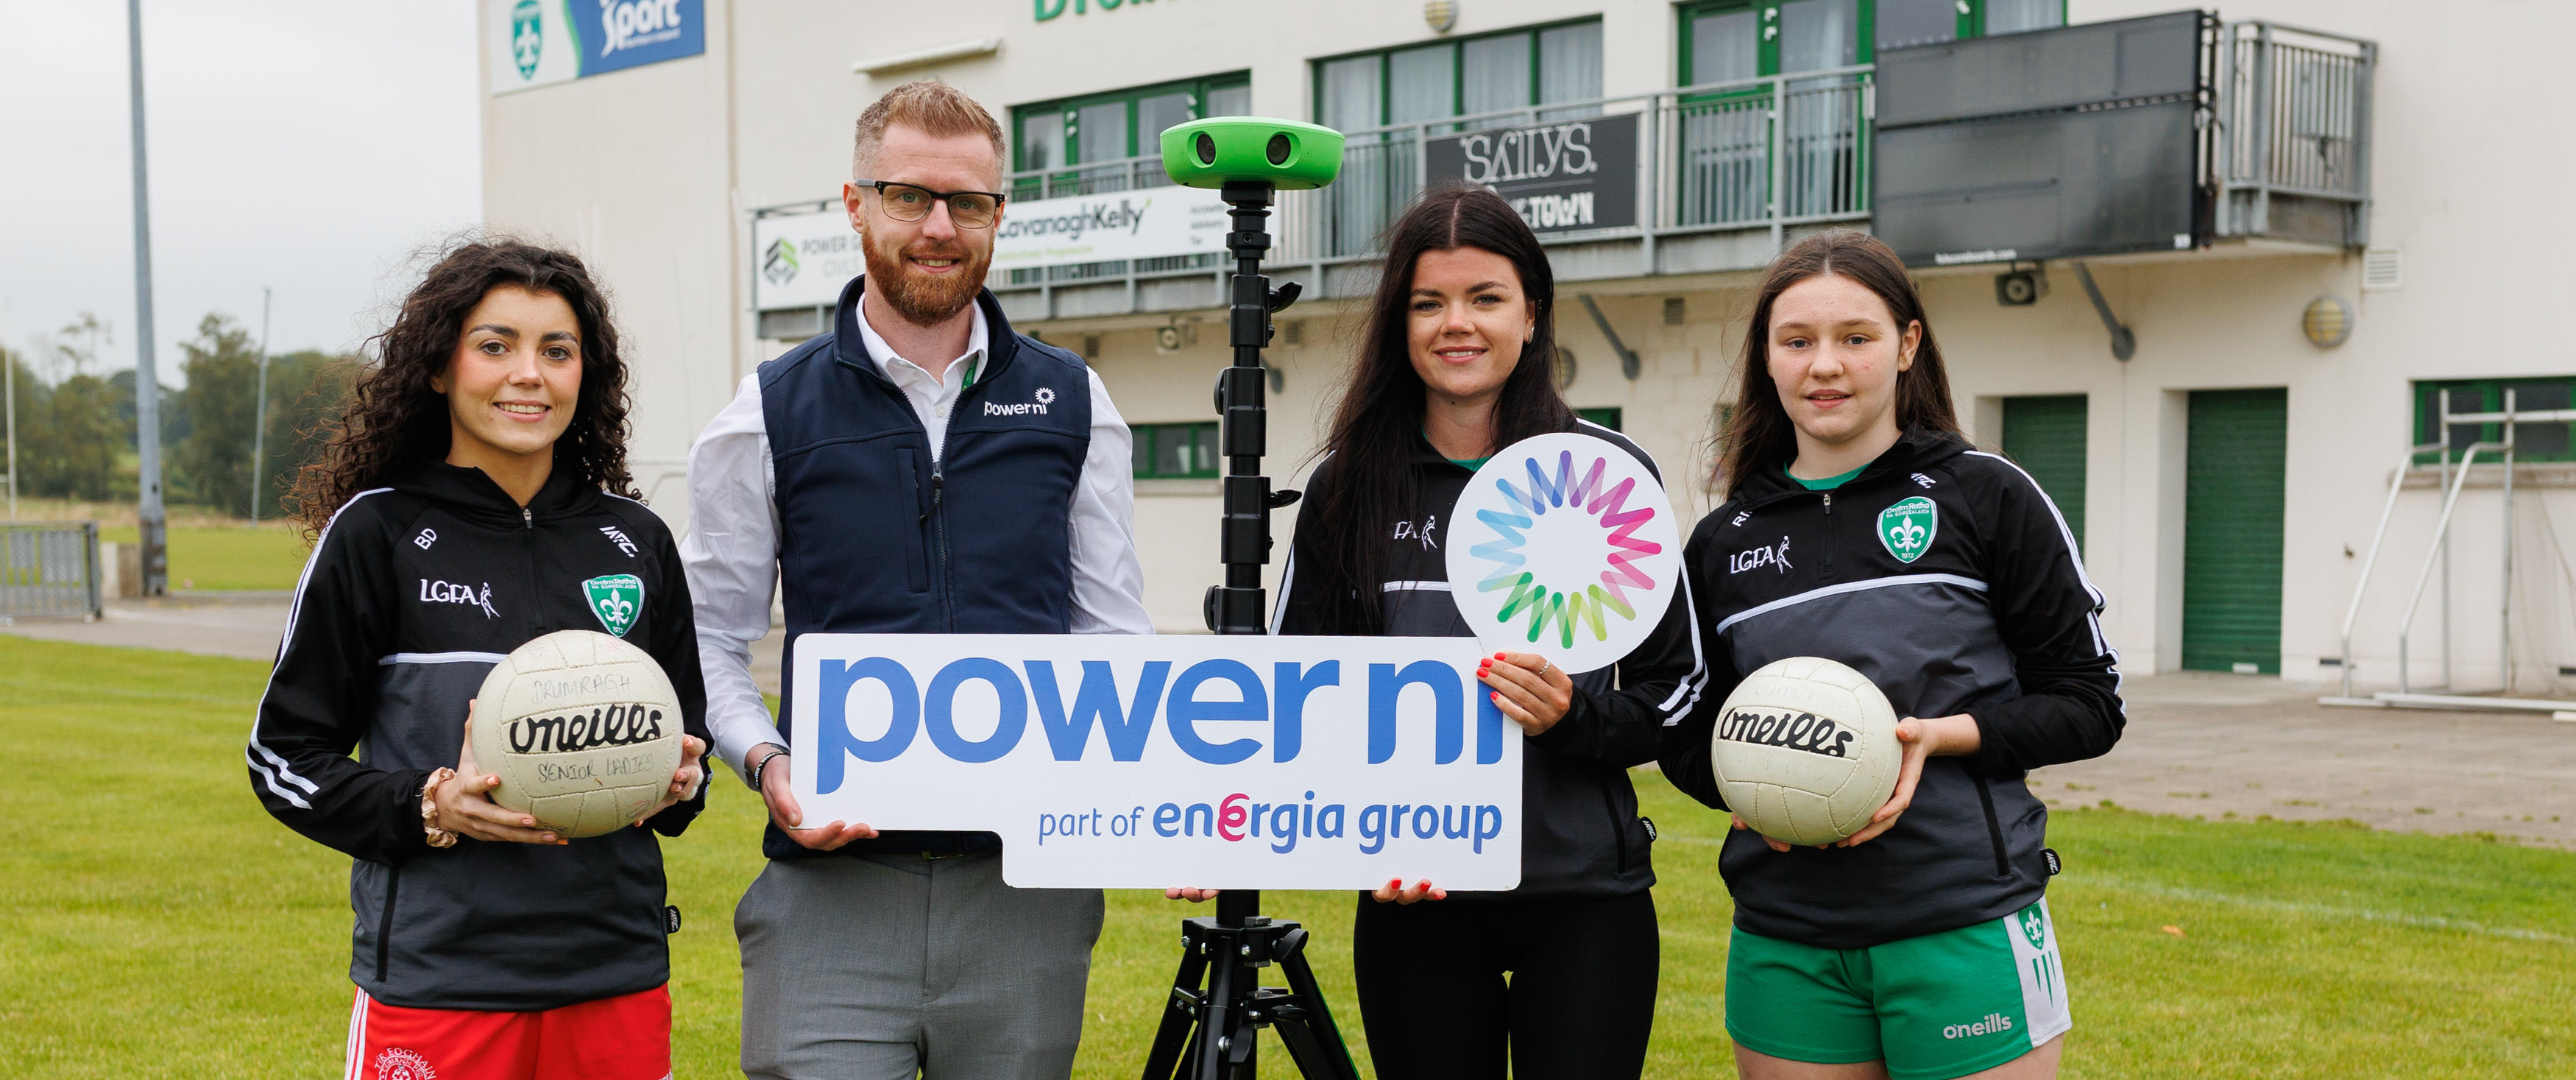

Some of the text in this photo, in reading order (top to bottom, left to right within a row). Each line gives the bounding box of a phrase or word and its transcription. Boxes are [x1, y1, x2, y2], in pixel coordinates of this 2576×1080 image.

[414, 528, 437, 550] BD
[1730, 546, 1776, 574] LGFA
[420, 579, 480, 606] LGFA
[531, 674, 631, 705] DRUMRAGH
[816, 656, 1340, 795] power
[538, 753, 655, 783] SENIOR LADIES
[1038, 790, 1502, 855] part of energia group
